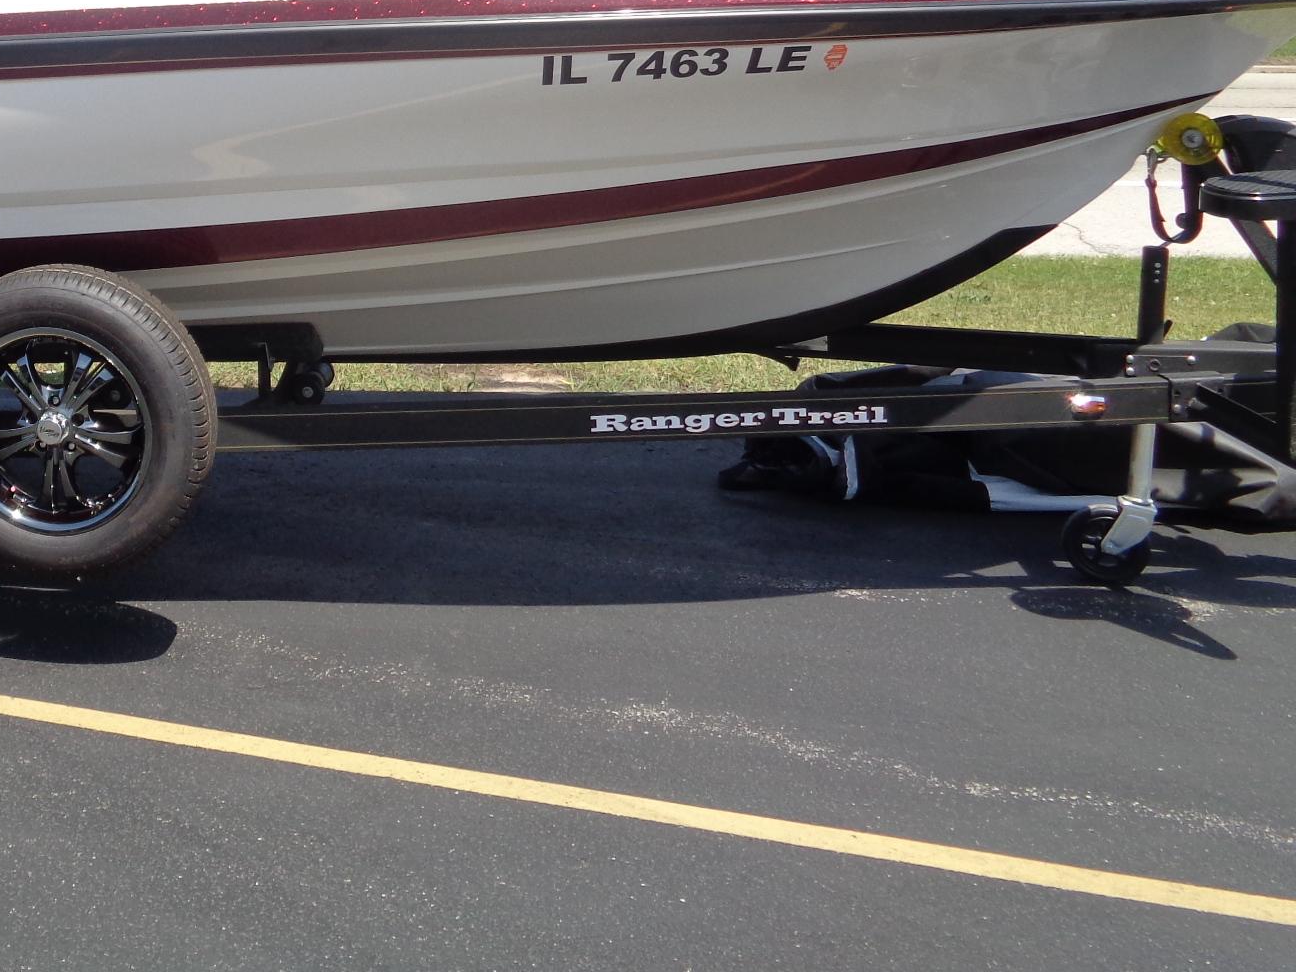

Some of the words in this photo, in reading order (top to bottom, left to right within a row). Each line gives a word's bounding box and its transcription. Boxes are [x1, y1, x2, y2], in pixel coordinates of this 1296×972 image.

[542, 54, 588, 85] IL
[607, 47, 729, 83] 7463
[745, 45, 812, 74] LE
[590, 410, 765, 433] Ranger
[772, 406, 888, 426] Trail
